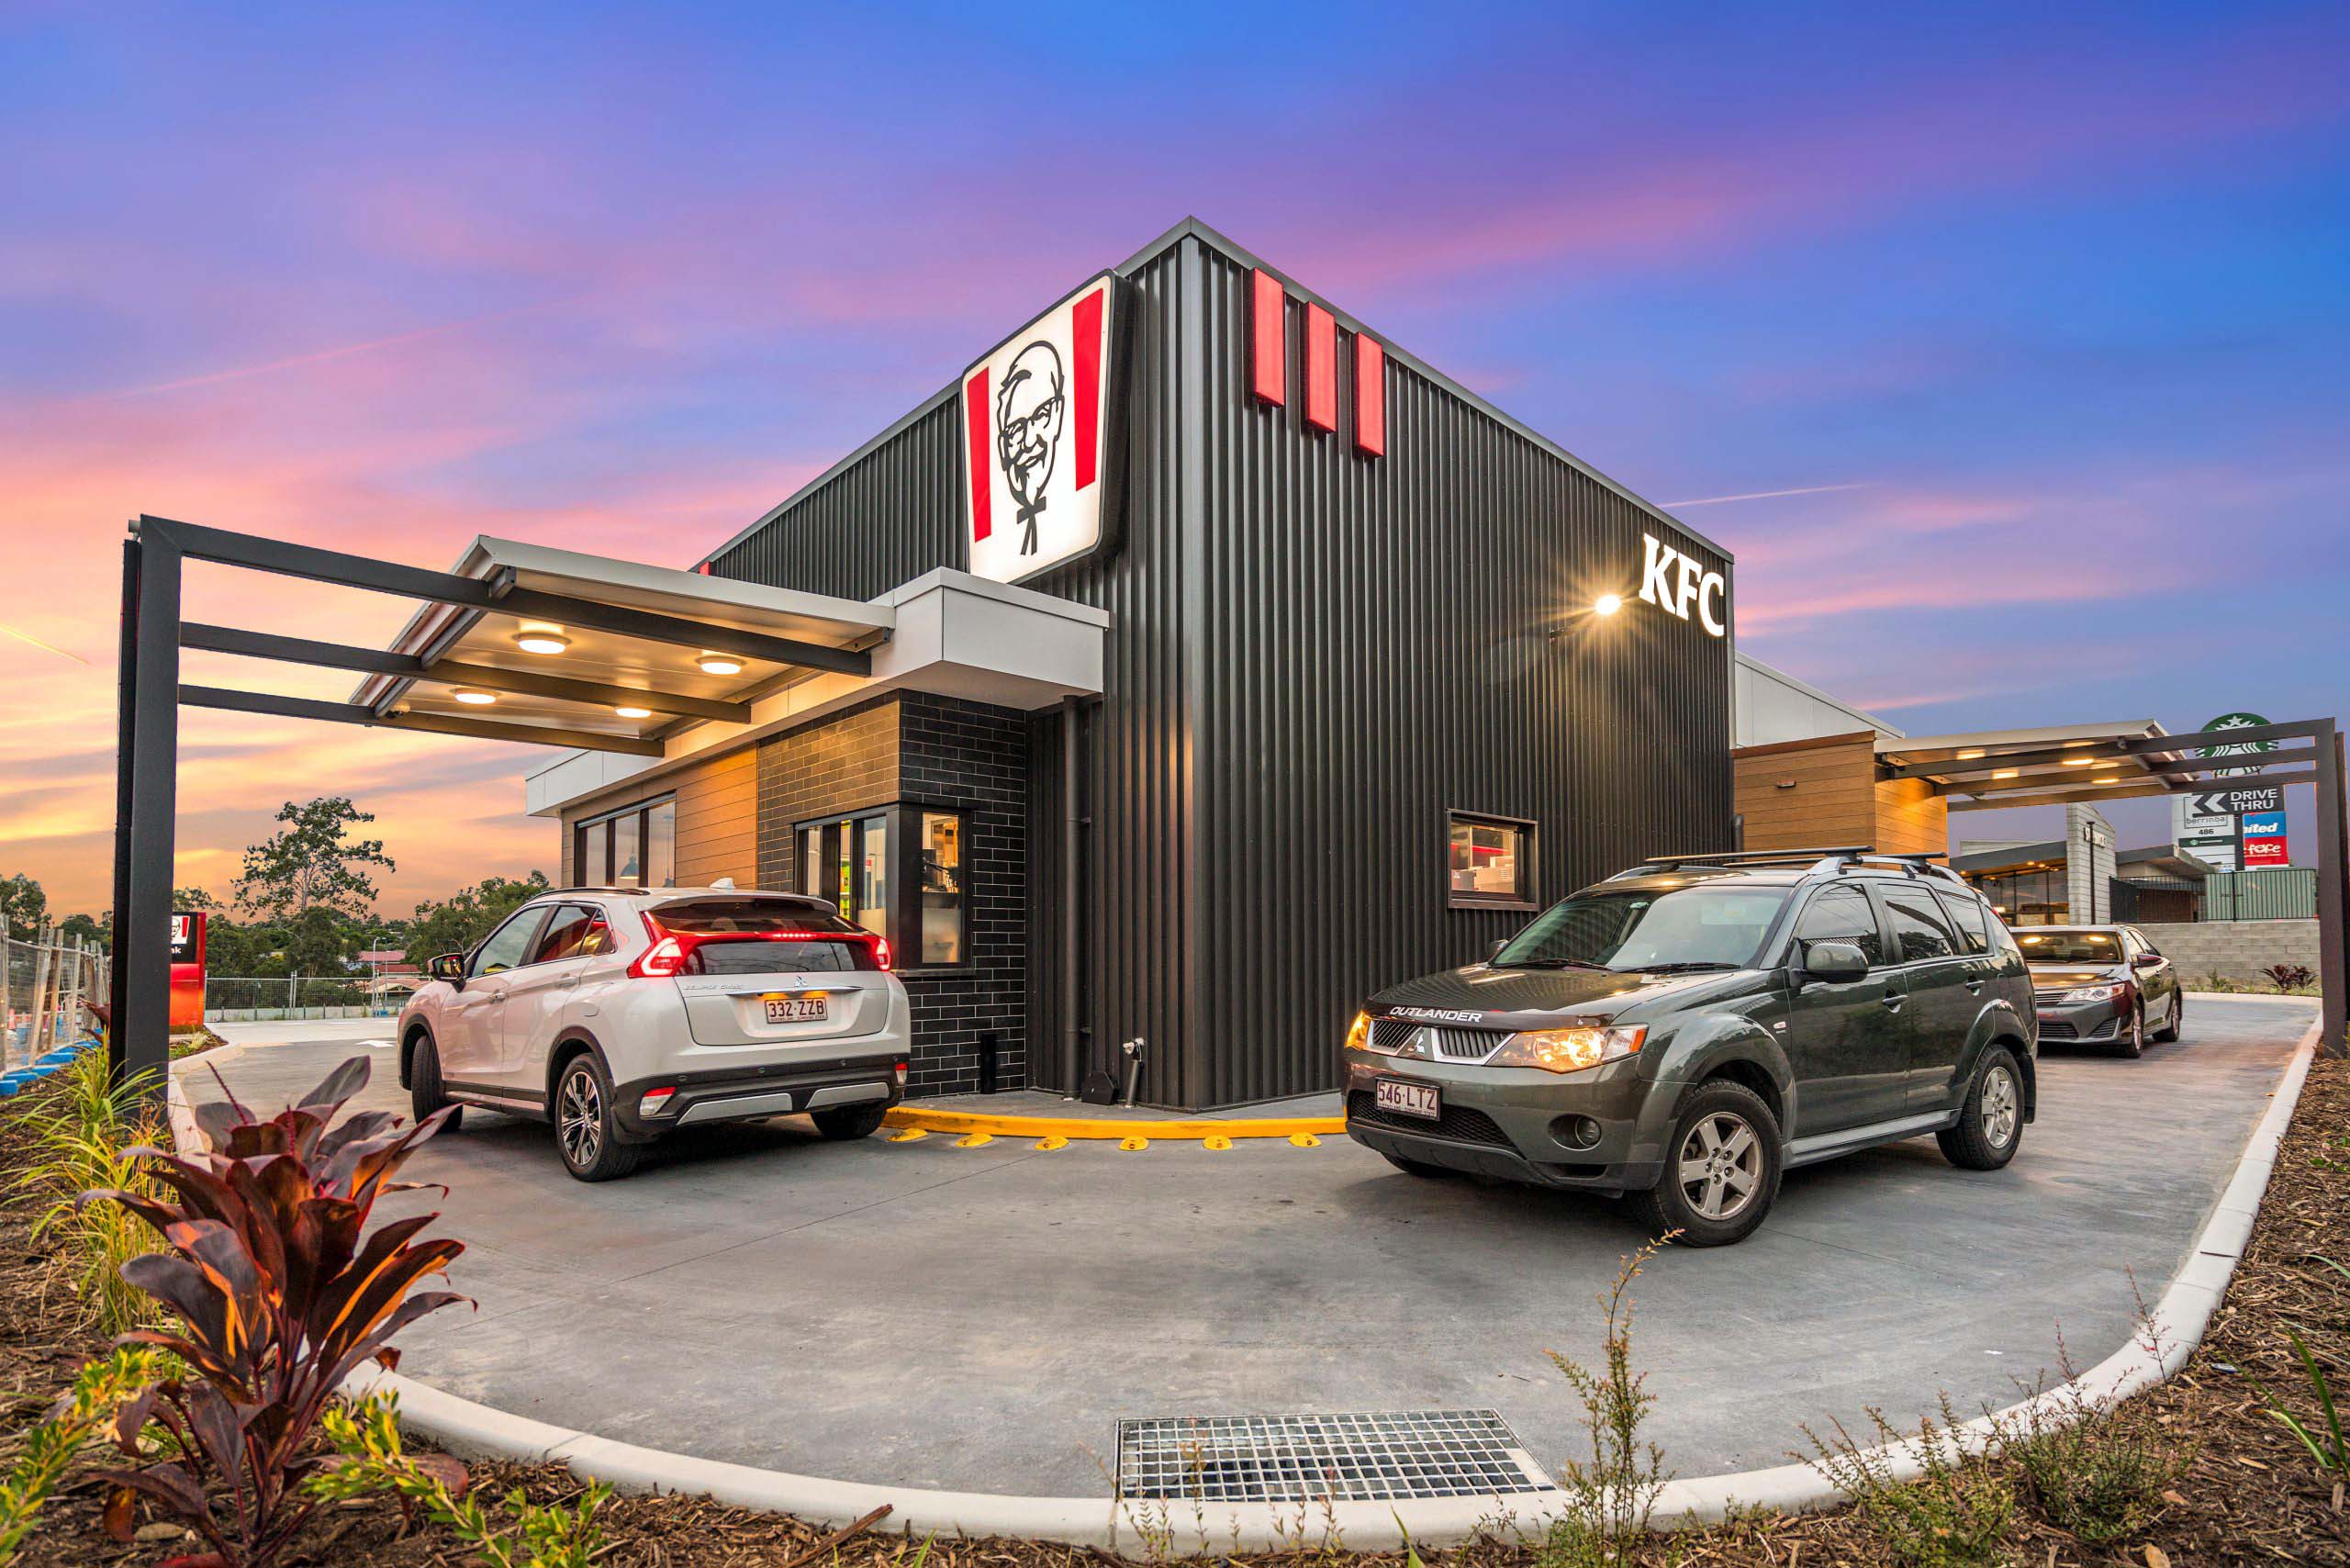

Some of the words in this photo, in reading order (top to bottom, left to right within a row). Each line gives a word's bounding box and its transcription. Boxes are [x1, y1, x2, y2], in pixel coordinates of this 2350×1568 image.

[1639, 532, 1725, 637] KFC
[2230, 789, 2277, 801] DRIVE
[2230, 799, 2275, 812] THRU
[2186, 816, 2225, 824] berrinba
[1389, 1006, 1483, 1023] OUTLANDER
